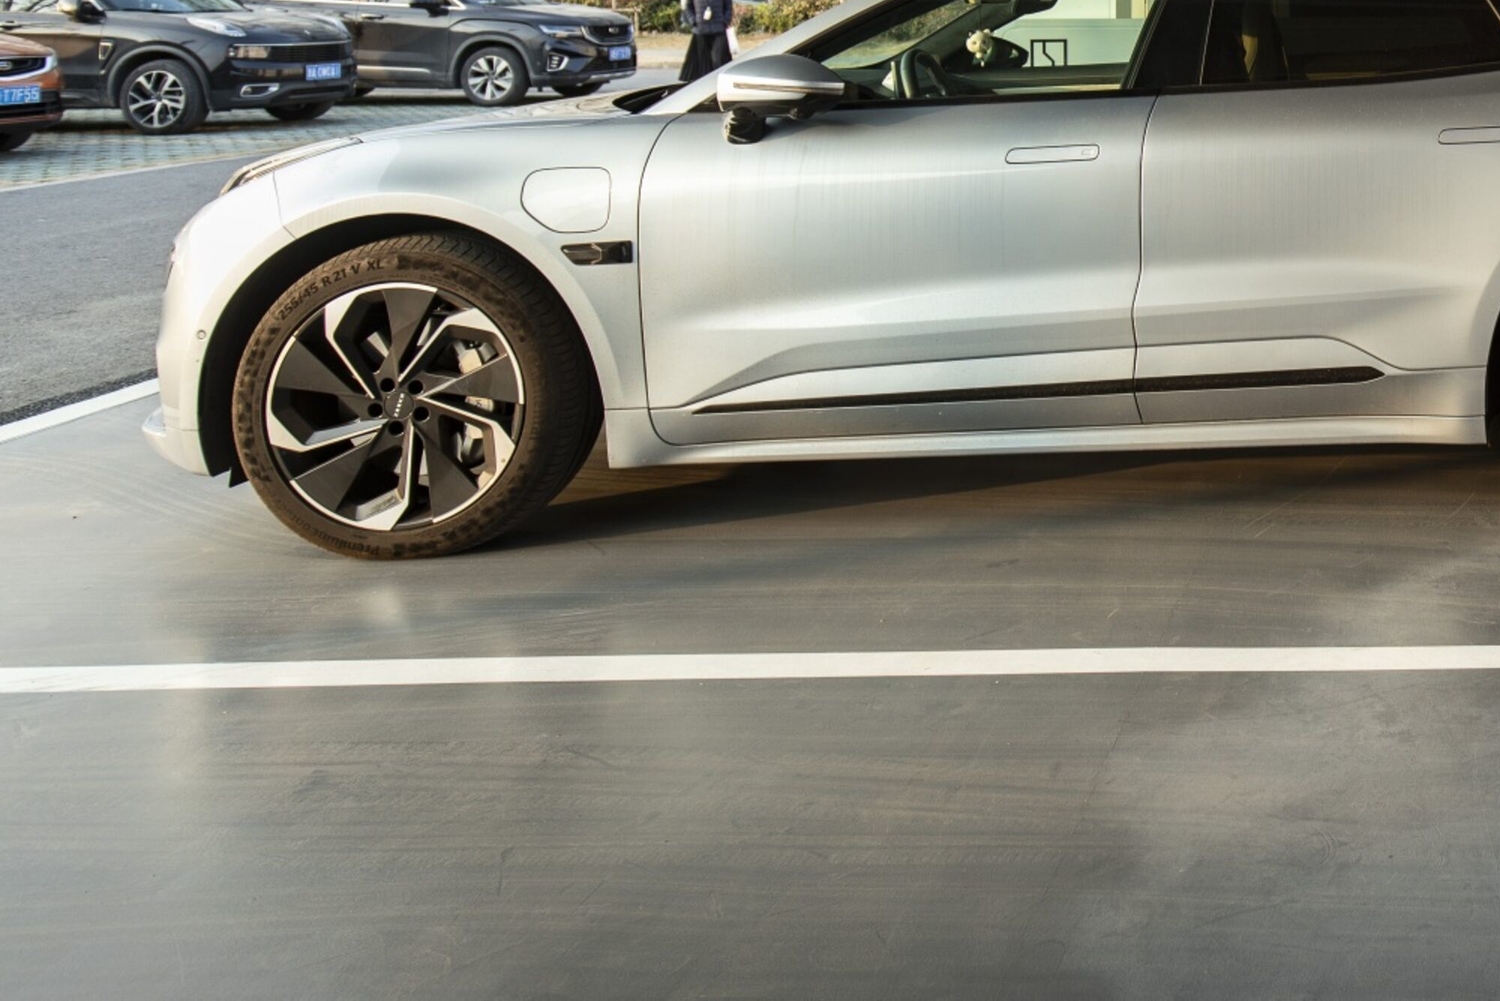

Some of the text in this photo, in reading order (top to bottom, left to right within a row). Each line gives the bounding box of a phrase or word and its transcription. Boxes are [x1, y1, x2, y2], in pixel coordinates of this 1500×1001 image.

[278, 282, 320, 321] 255/45
[351, 262, 361, 275] V
[366, 259, 385, 272] XL
